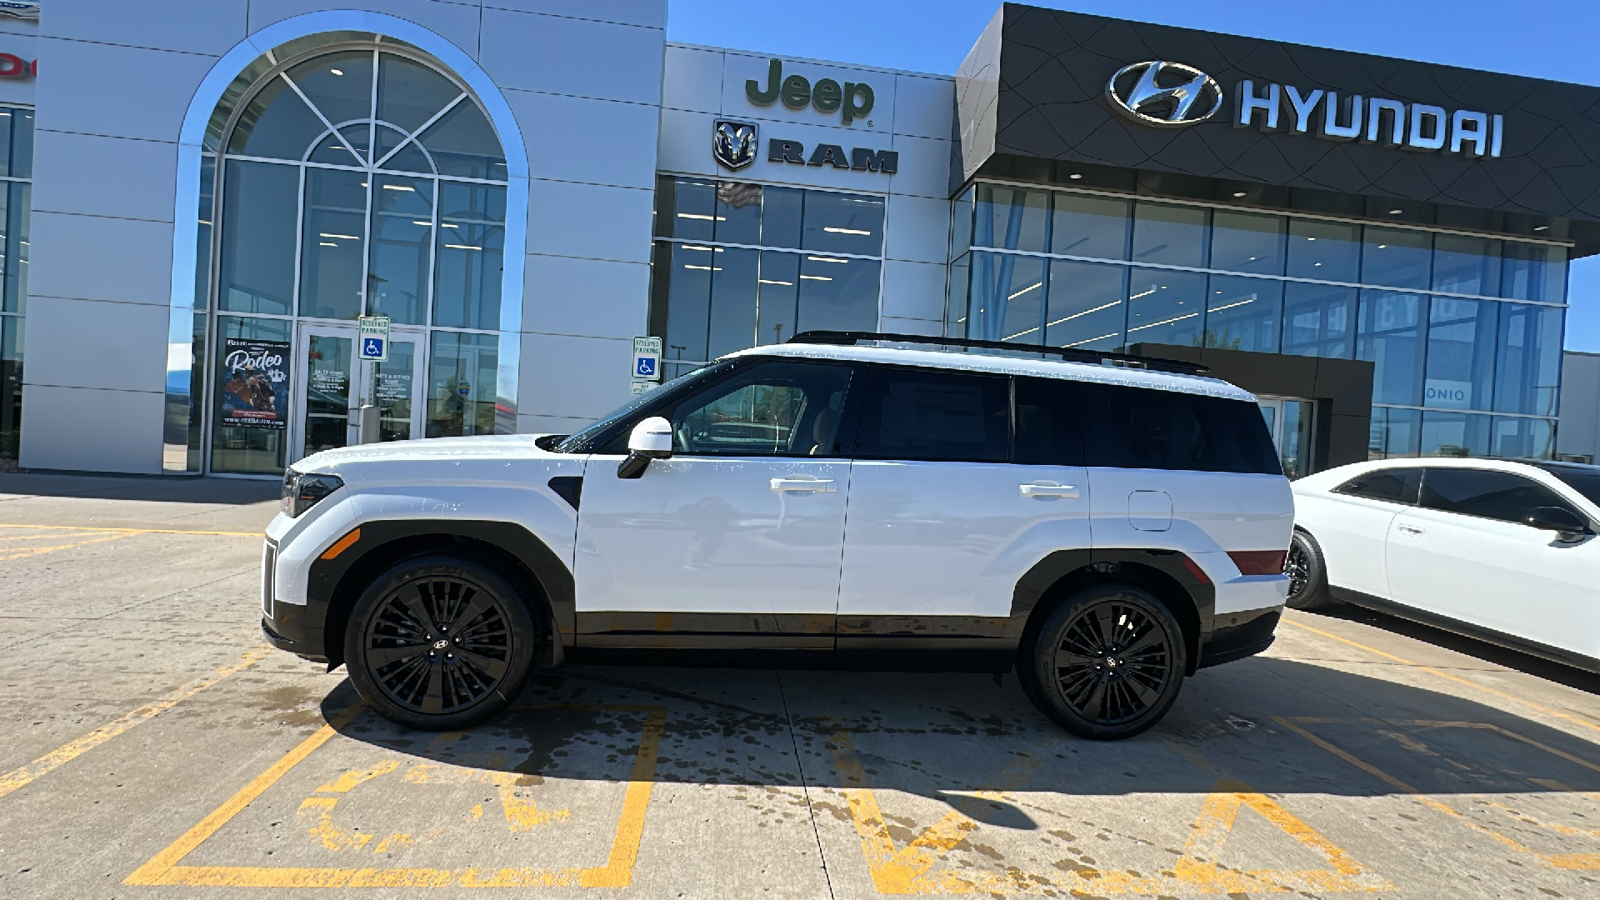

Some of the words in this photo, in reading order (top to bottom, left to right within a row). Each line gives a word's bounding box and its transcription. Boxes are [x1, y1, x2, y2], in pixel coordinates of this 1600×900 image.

[745, 59, 875, 126] Jeep
[1236, 79, 1503, 158] HYUNDAI
[768, 138, 898, 174] RAM
[361, 327, 387, 335] PARKING
[362, 320, 387, 328] RESERVED
[225, 350, 282, 374] Rodeo
